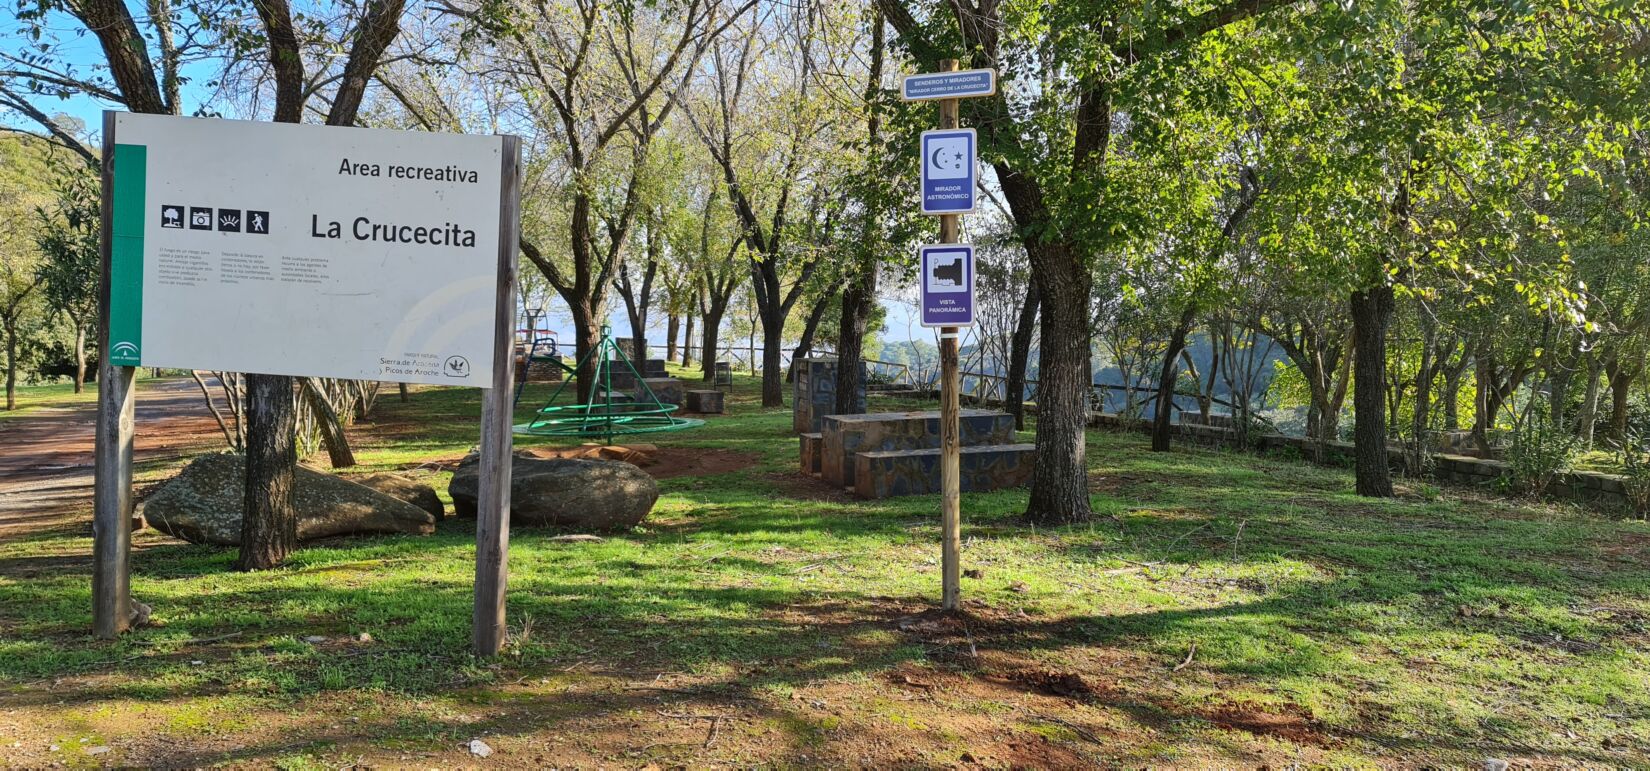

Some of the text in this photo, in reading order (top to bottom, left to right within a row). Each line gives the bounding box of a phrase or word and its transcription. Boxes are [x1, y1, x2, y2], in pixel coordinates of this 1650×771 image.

[949, 76, 982, 84] MIRADORES
[339, 158, 478, 183] Area recreativa
[311, 214, 476, 248] La Crucecita
[380, 358, 401, 366] Sierra
[402, 358, 410, 366] de
[385, 366, 403, 375] Picos
[404, 367, 413, 375] de
[414, 368, 439, 376] Aroche
